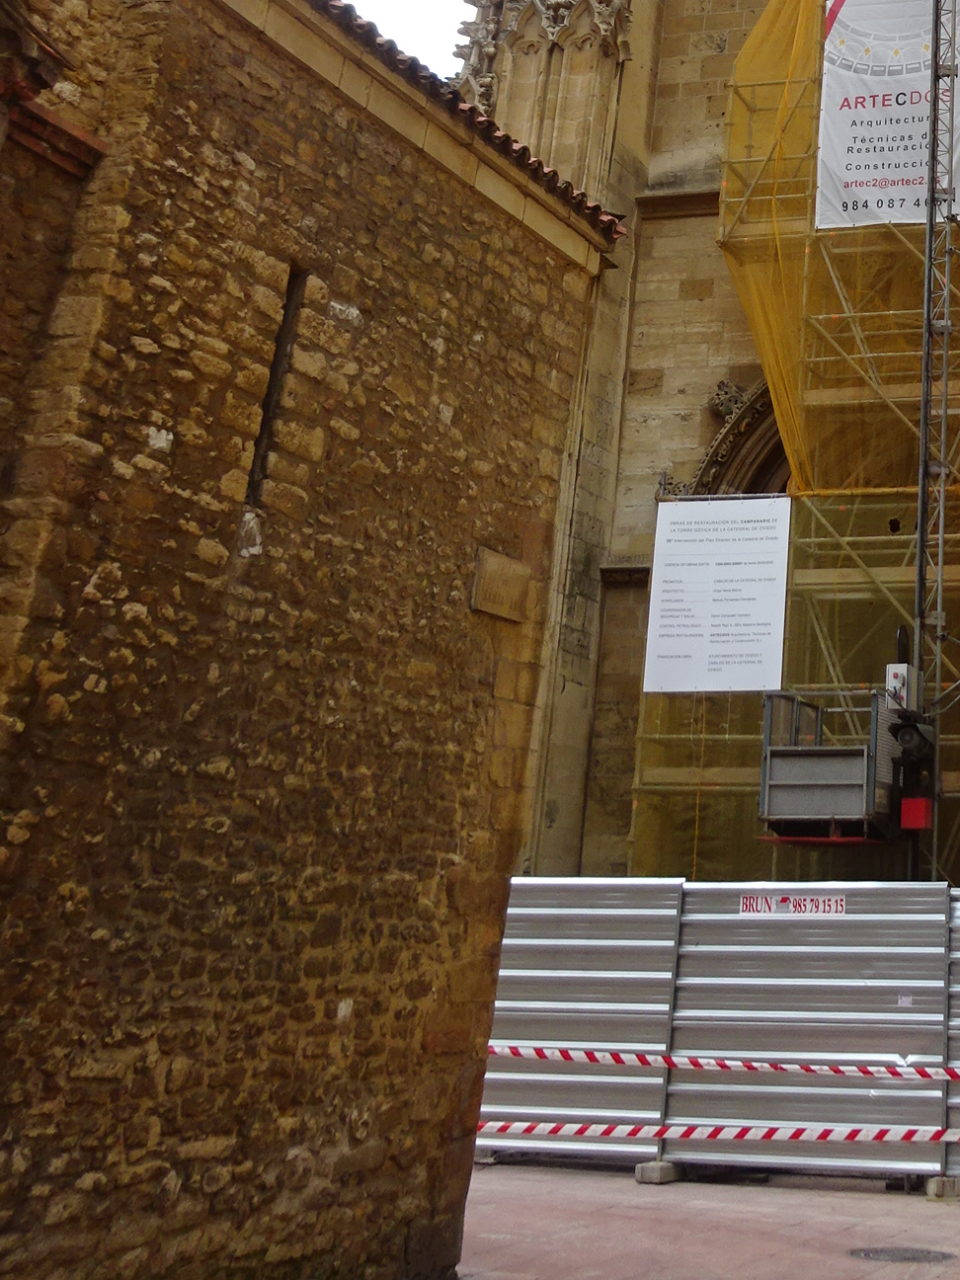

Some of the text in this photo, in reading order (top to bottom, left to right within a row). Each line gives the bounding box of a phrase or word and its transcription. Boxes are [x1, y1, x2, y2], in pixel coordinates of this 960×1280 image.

[850, 115, 932, 128] Arquitectur
[841, 200, 869, 212] 984
[876, 198, 905, 209] 087
[741, 896, 844, 914] BRUN 985 79 15 15
